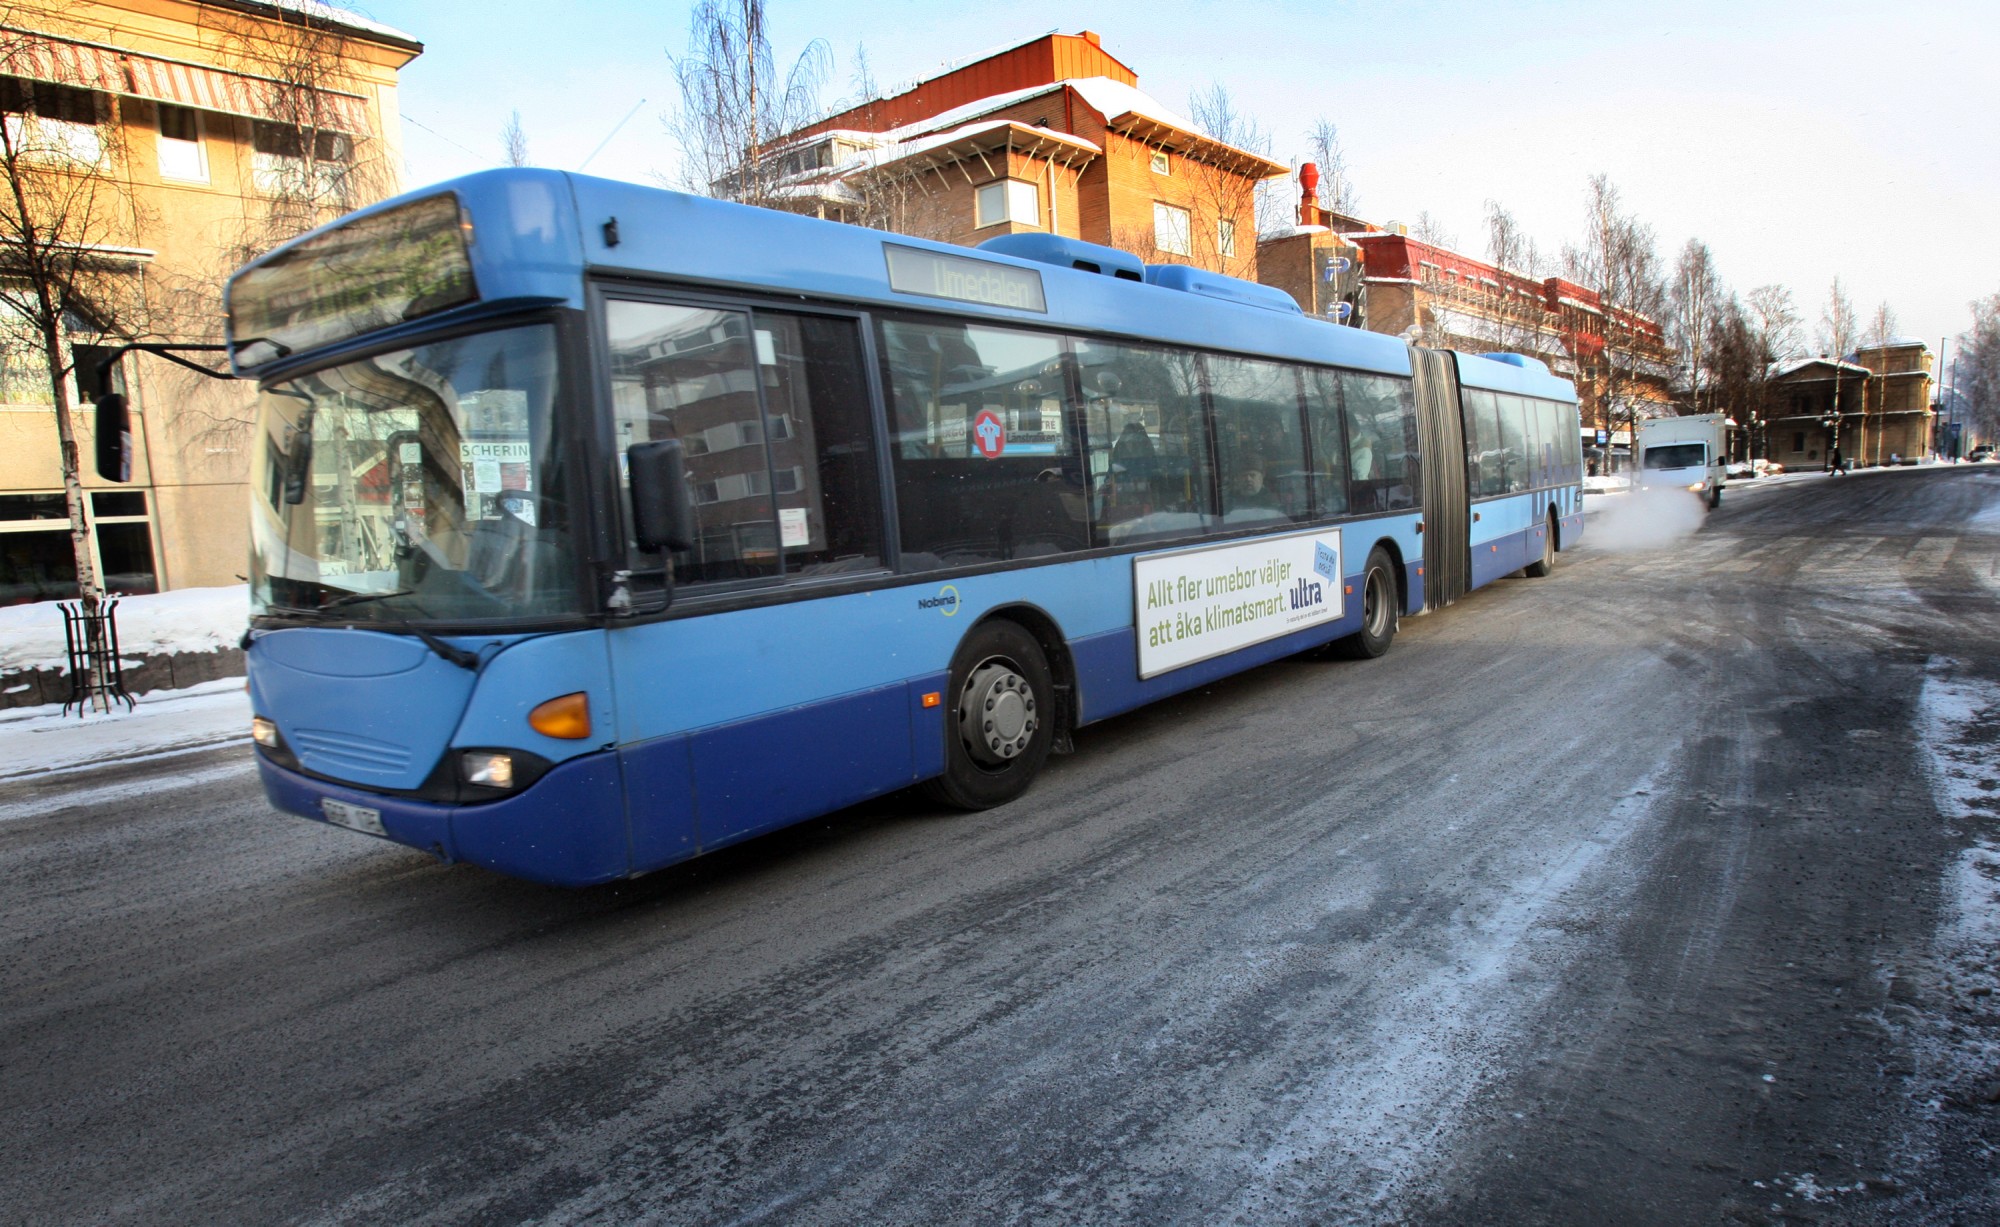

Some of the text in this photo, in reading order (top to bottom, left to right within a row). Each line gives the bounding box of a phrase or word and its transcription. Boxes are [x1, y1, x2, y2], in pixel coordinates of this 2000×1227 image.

[933, 259, 1030, 309] Umedalen
[918, 595, 956, 609] Nobina
[1147, 558, 1292, 610] Allt fler umebor väljer
[1289, 577, 1323, 610] ultra
[1149, 619, 1173, 648] att
[1176, 611, 1202, 640] åka
[1205, 592, 1287, 633] klimatsmart.
